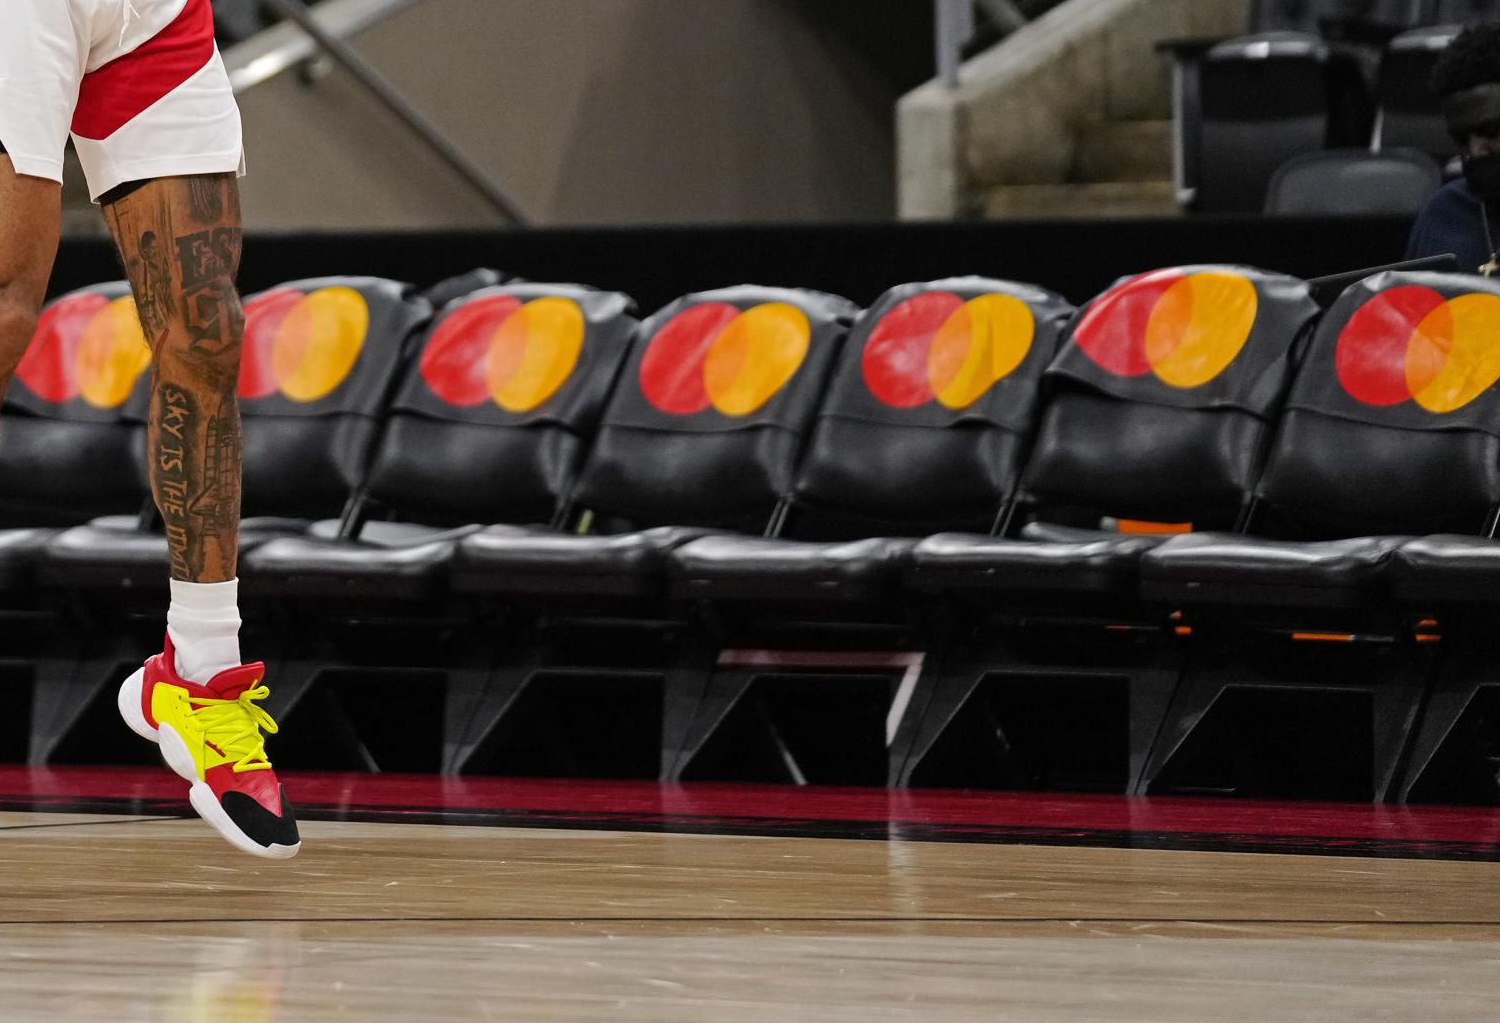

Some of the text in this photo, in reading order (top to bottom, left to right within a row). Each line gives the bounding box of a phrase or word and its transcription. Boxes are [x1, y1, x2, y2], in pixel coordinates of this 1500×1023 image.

[161, 386, 191, 440] SKY
[160, 445, 184, 474] IS
[161, 479, 188, 518] THE
